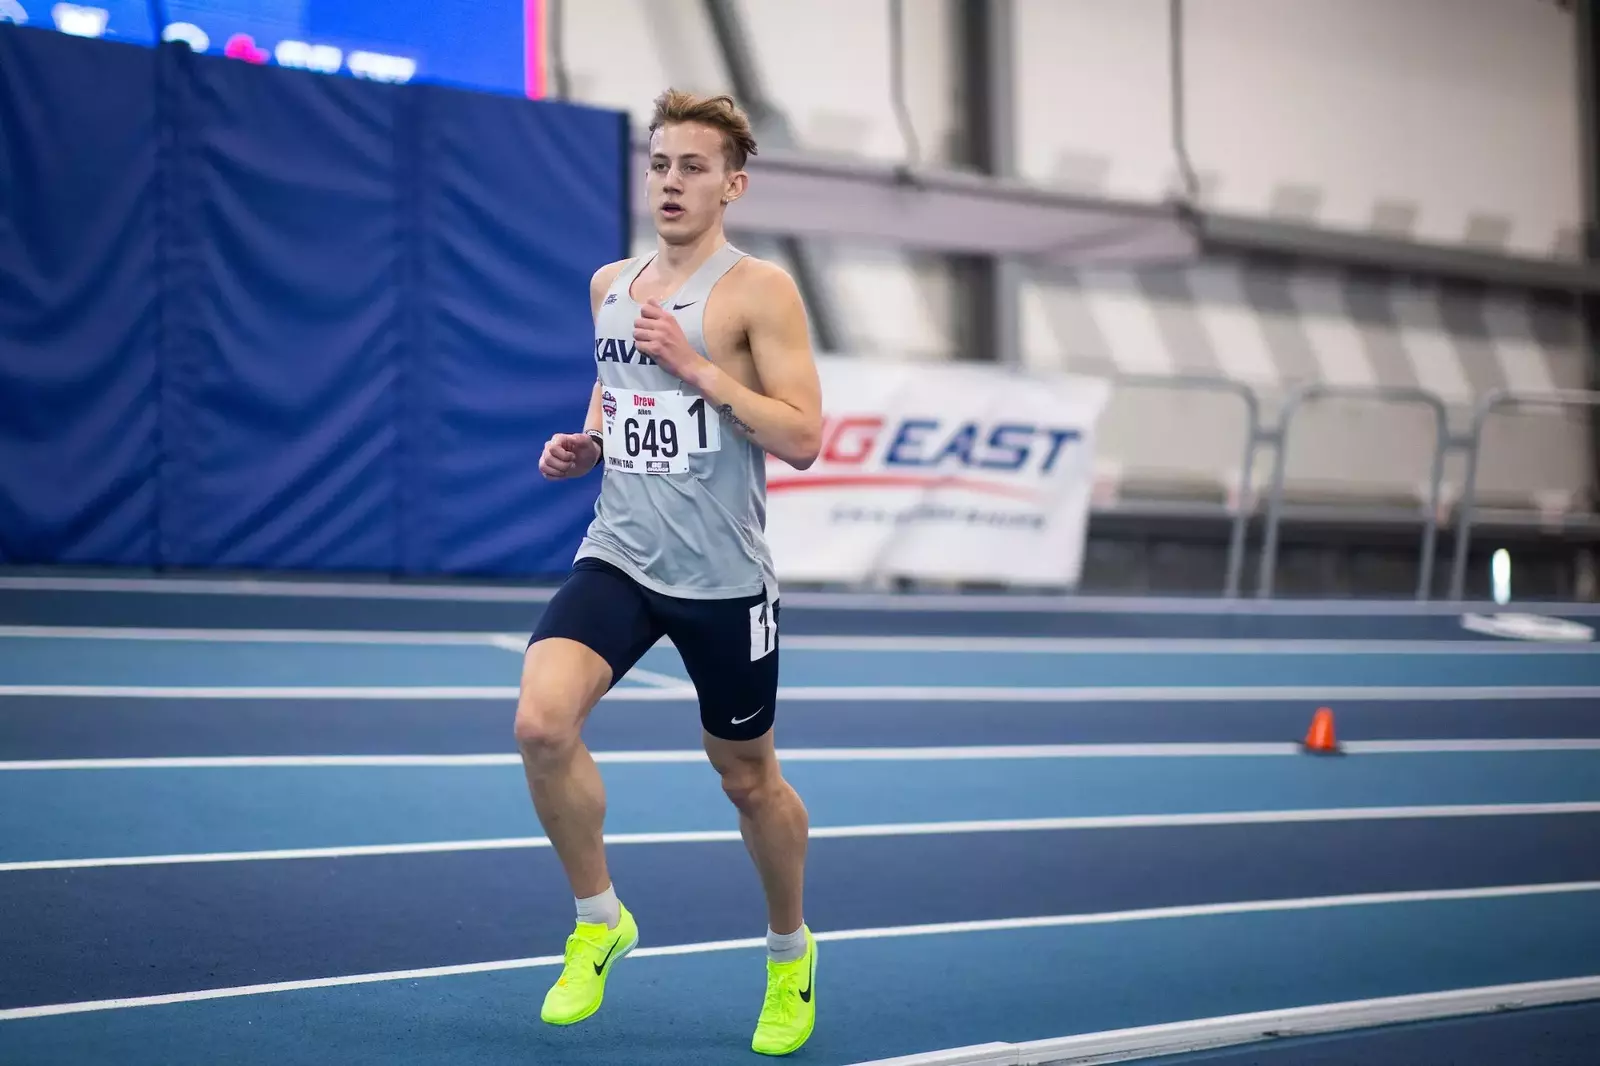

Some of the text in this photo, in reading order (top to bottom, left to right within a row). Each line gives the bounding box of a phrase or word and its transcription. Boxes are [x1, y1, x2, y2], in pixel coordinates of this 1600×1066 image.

[596, 338, 658, 365] XAV
[634, 395, 655, 406] Drew
[624, 417, 679, 458] 649
[688, 398, 708, 449] 1
[885, 418, 1082, 475] EAST
[623, 460, 634, 469] TAG
